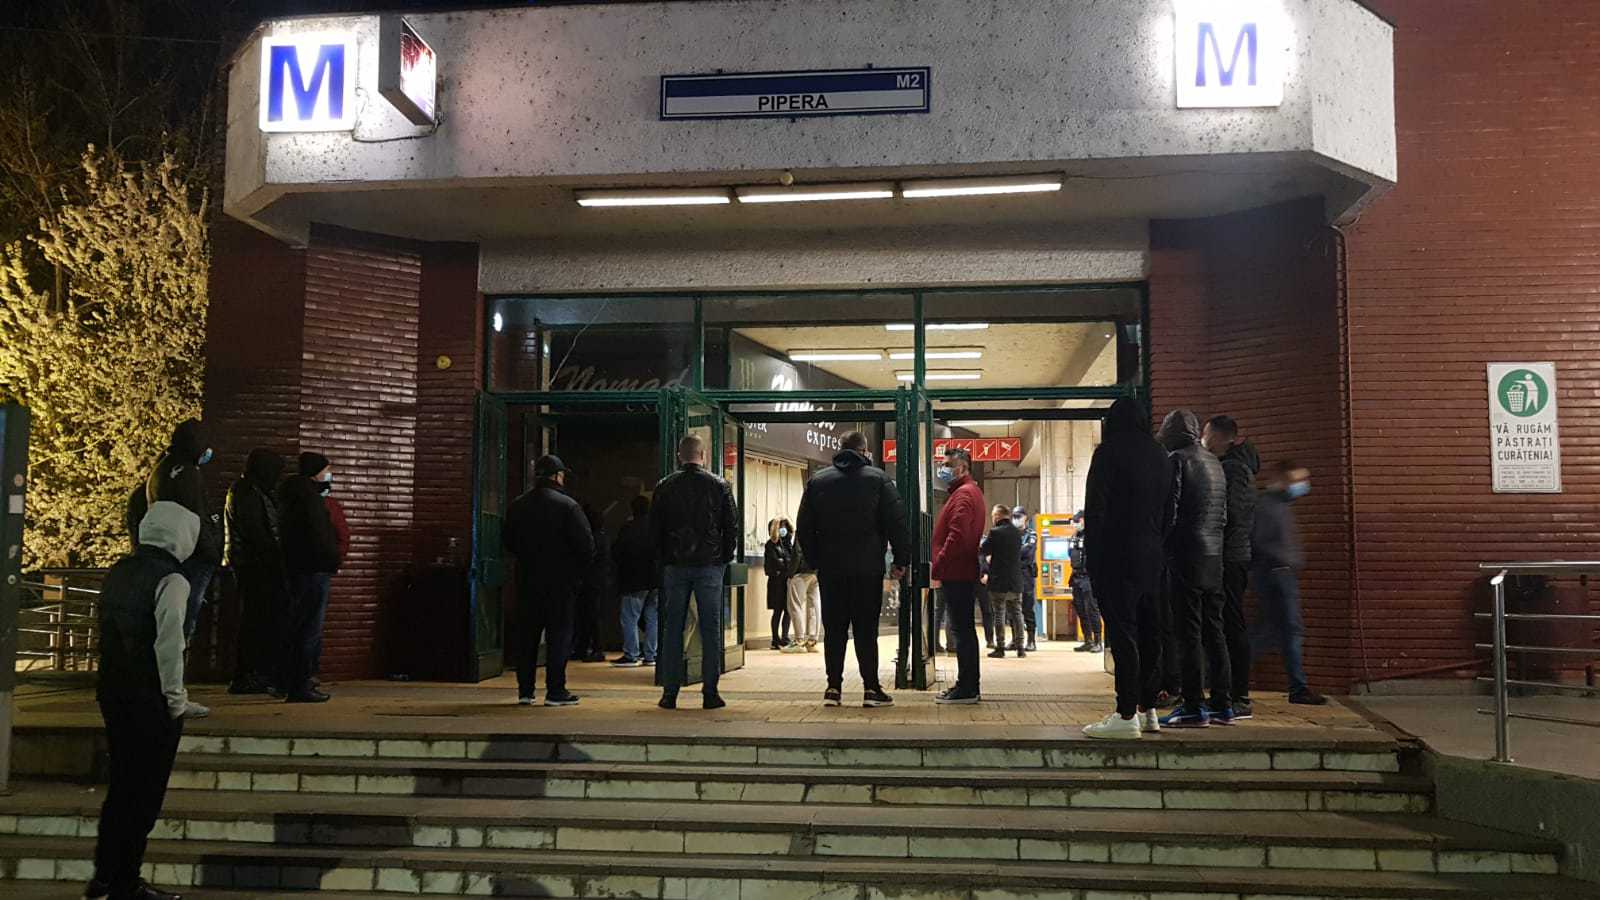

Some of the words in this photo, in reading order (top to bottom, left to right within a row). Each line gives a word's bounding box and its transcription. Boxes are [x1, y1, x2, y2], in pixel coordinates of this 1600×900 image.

[1195, 22, 1257, 87] M
[267, 44, 345, 122] M
[896, 74, 920, 88] M2
[758, 94, 829, 111] PIPERA
[1496, 422, 1509, 434] VĂ
[1516, 422, 1551, 434] RUGĂM
